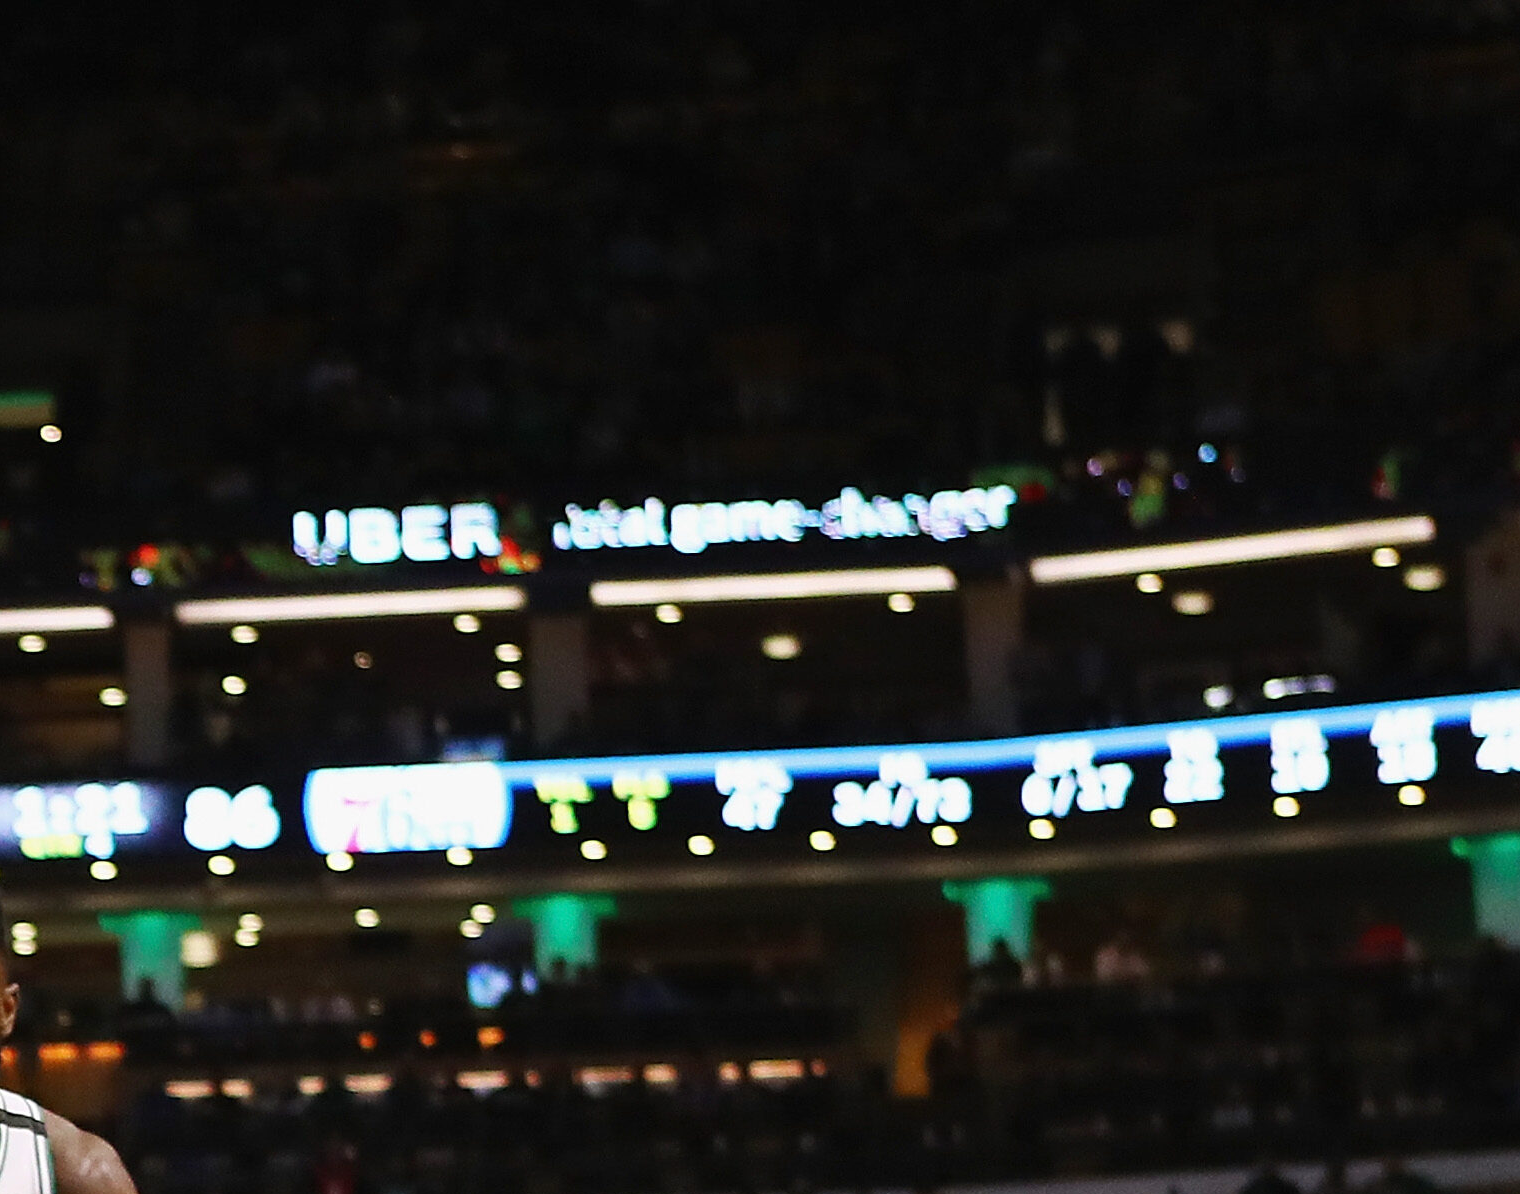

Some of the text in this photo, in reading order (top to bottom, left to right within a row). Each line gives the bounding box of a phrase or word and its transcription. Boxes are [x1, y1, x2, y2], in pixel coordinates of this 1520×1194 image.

[292, 502, 502, 567] UBER
[670, 484, 1018, 554] game-changer
[183, 785, 281, 851] 86
